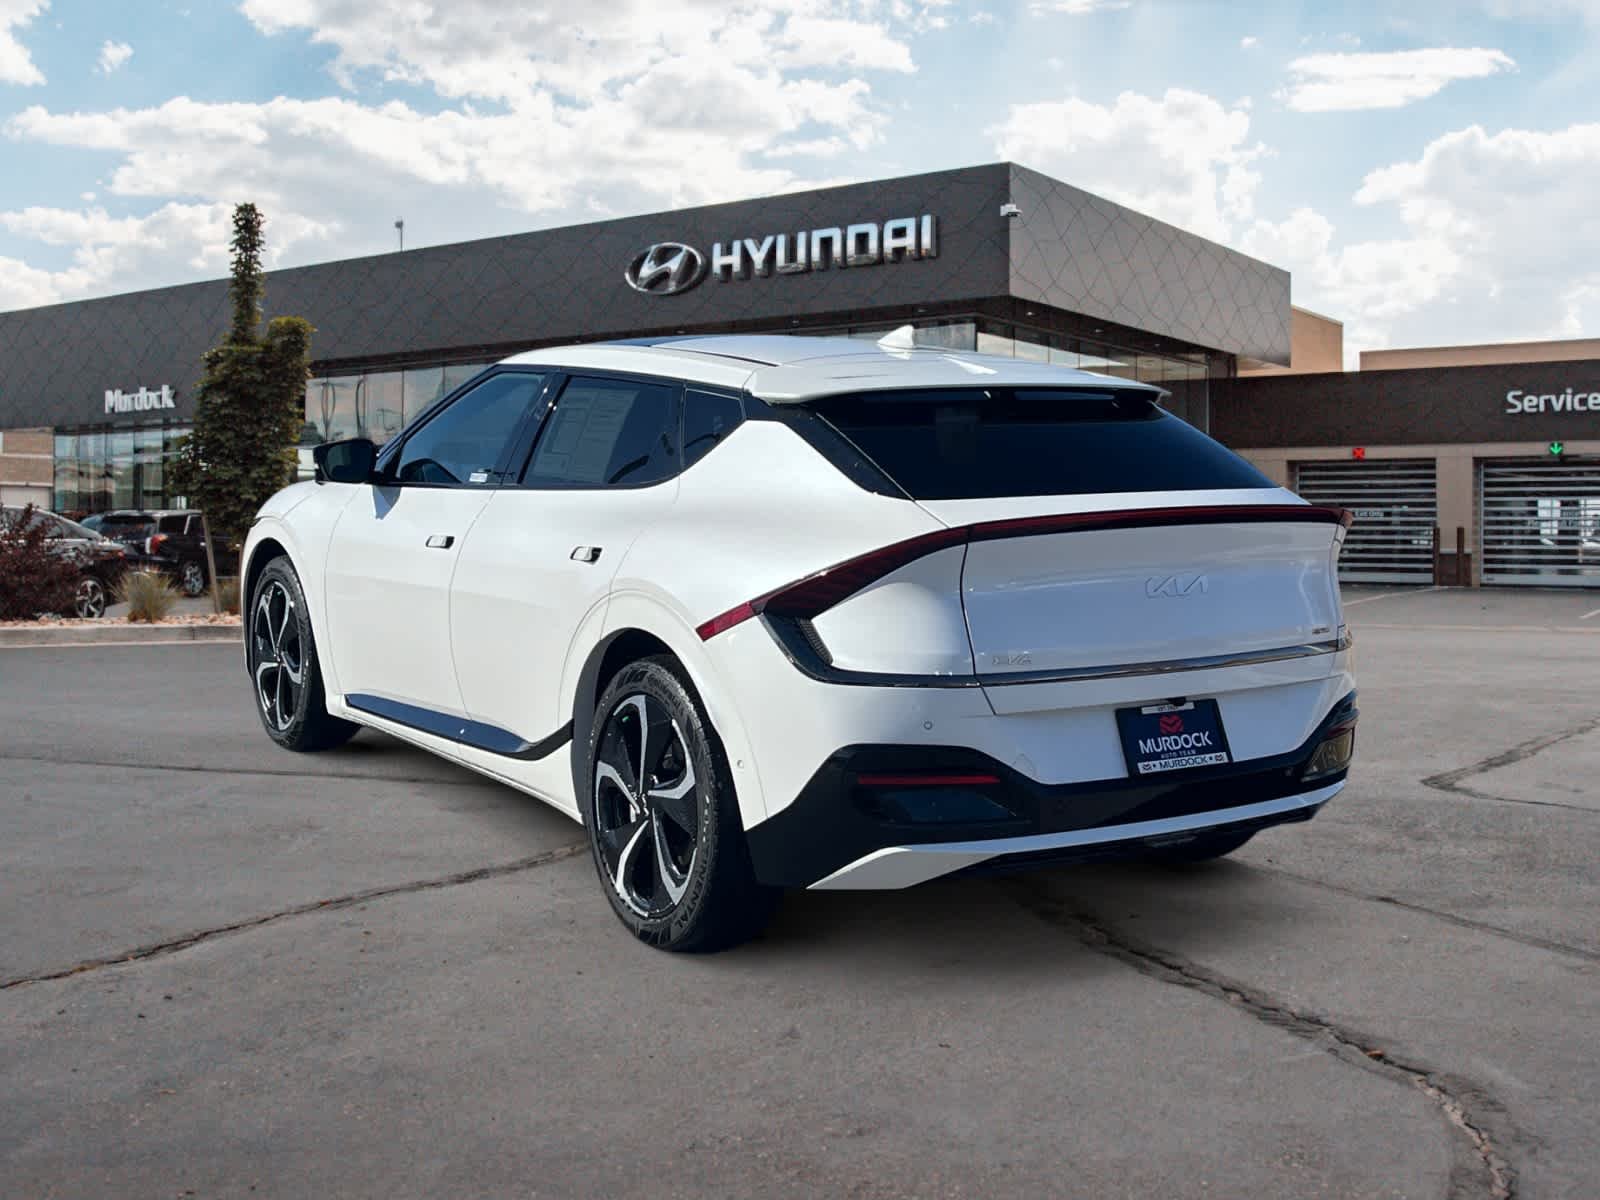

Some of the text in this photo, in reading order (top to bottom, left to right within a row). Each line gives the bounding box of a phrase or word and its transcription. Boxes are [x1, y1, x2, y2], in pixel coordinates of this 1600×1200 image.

[712, 214, 937, 282] HYUNDAI
[104, 384, 176, 414] Murdock
[1505, 387, 1600, 414] Service
[1144, 575, 1208, 600] KIA
[1138, 731, 1213, 754] MURDOCK
[1159, 755, 1208, 769] MURDOCK
